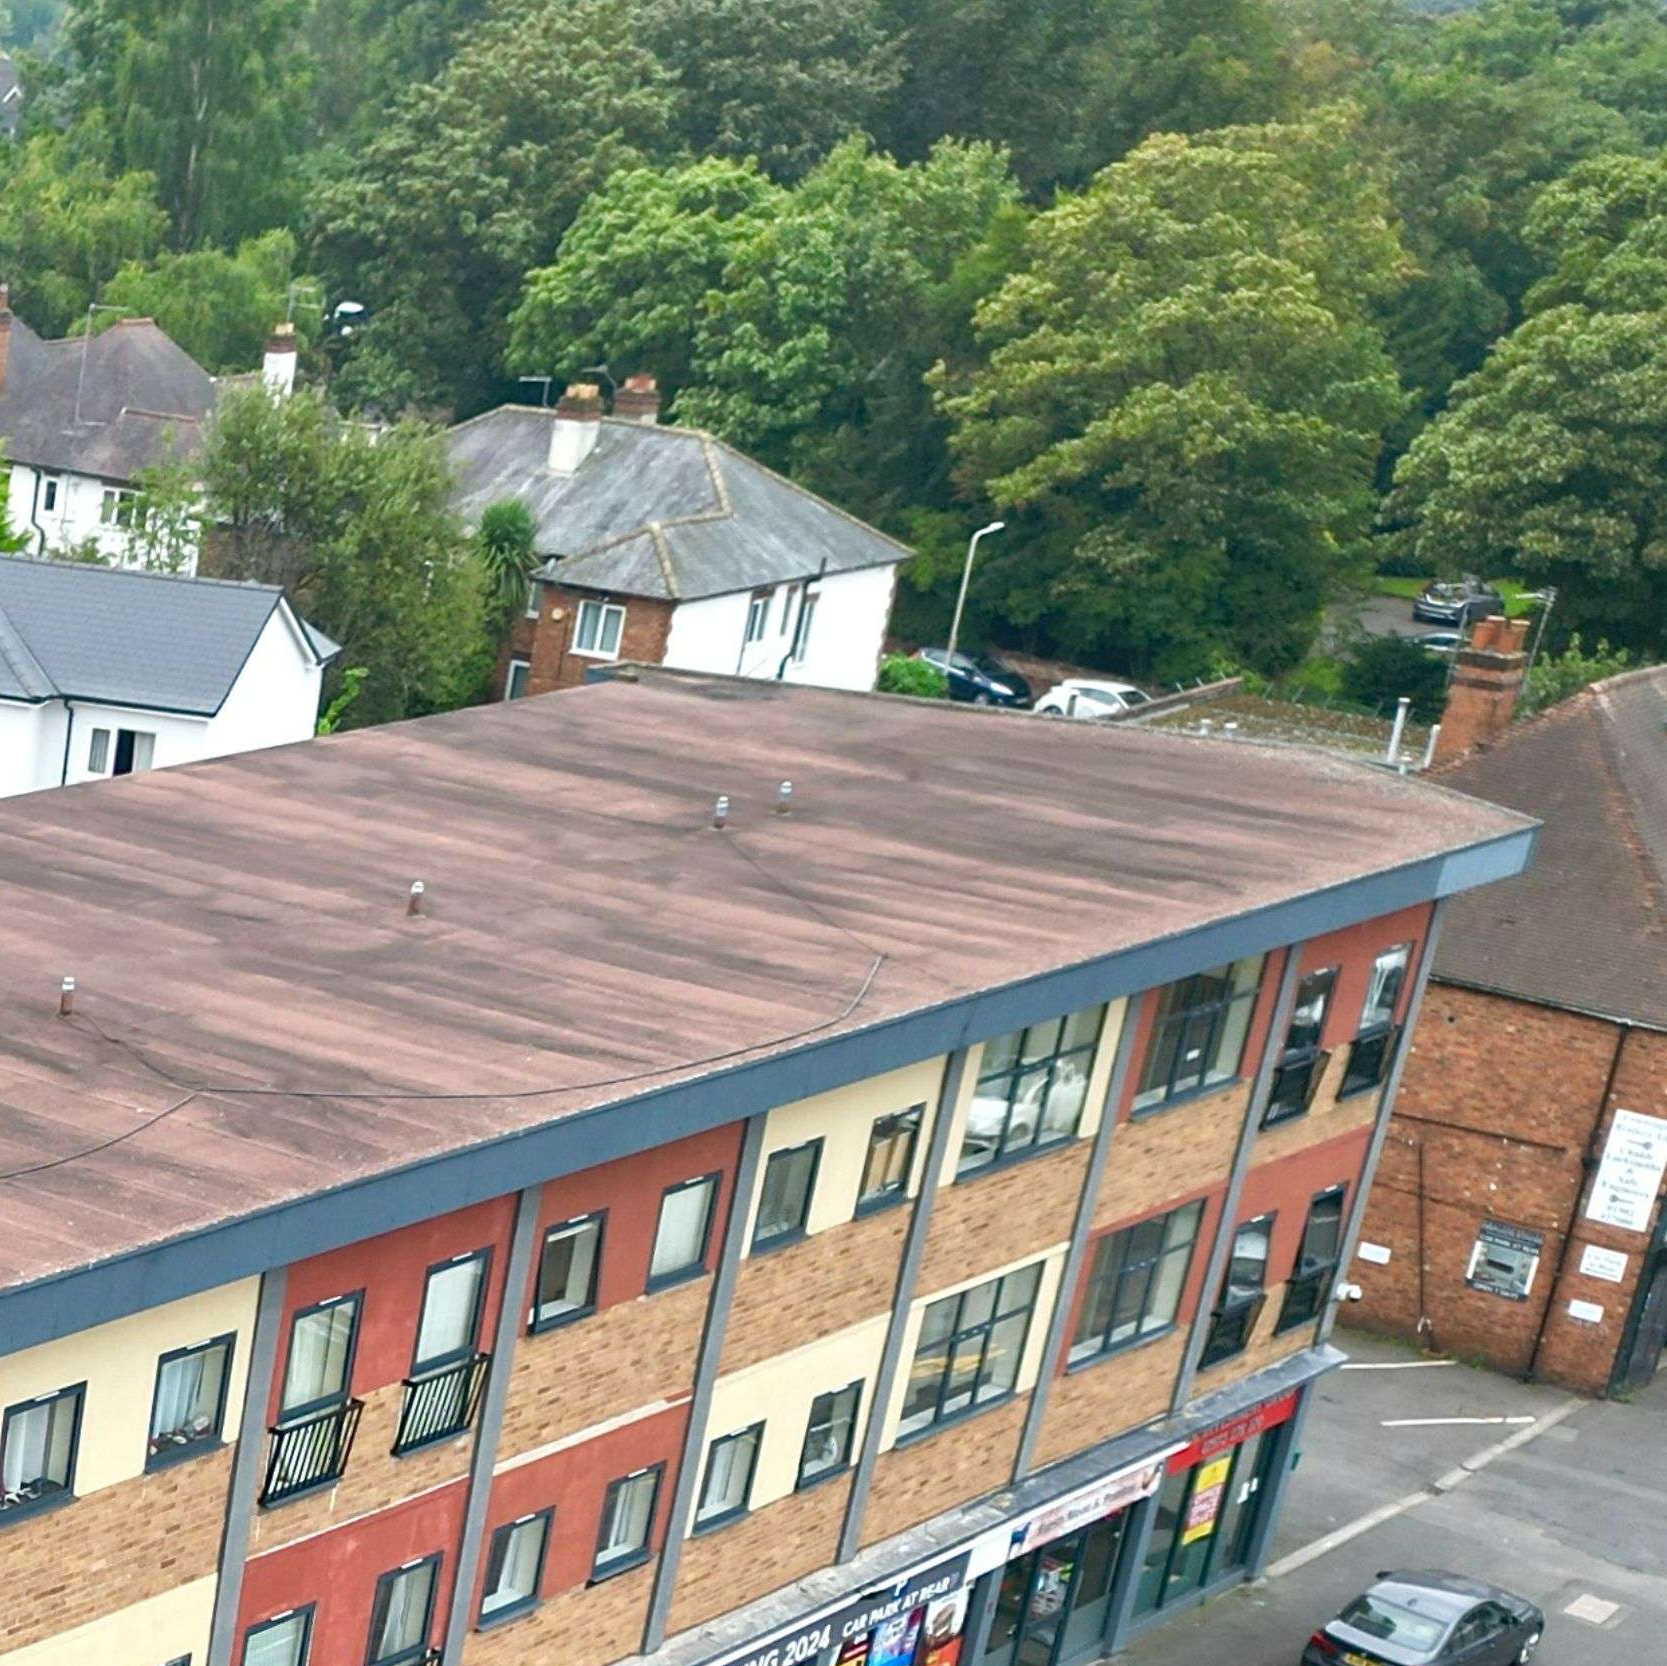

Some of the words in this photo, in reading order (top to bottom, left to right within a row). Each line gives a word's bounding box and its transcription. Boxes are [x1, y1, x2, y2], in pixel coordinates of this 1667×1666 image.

[842, 1613, 868, 1638] CAR
[868, 1598, 901, 1625] PARK
[901, 1591, 919, 1608] AT
[918, 1576, 951, 1603] REAR
